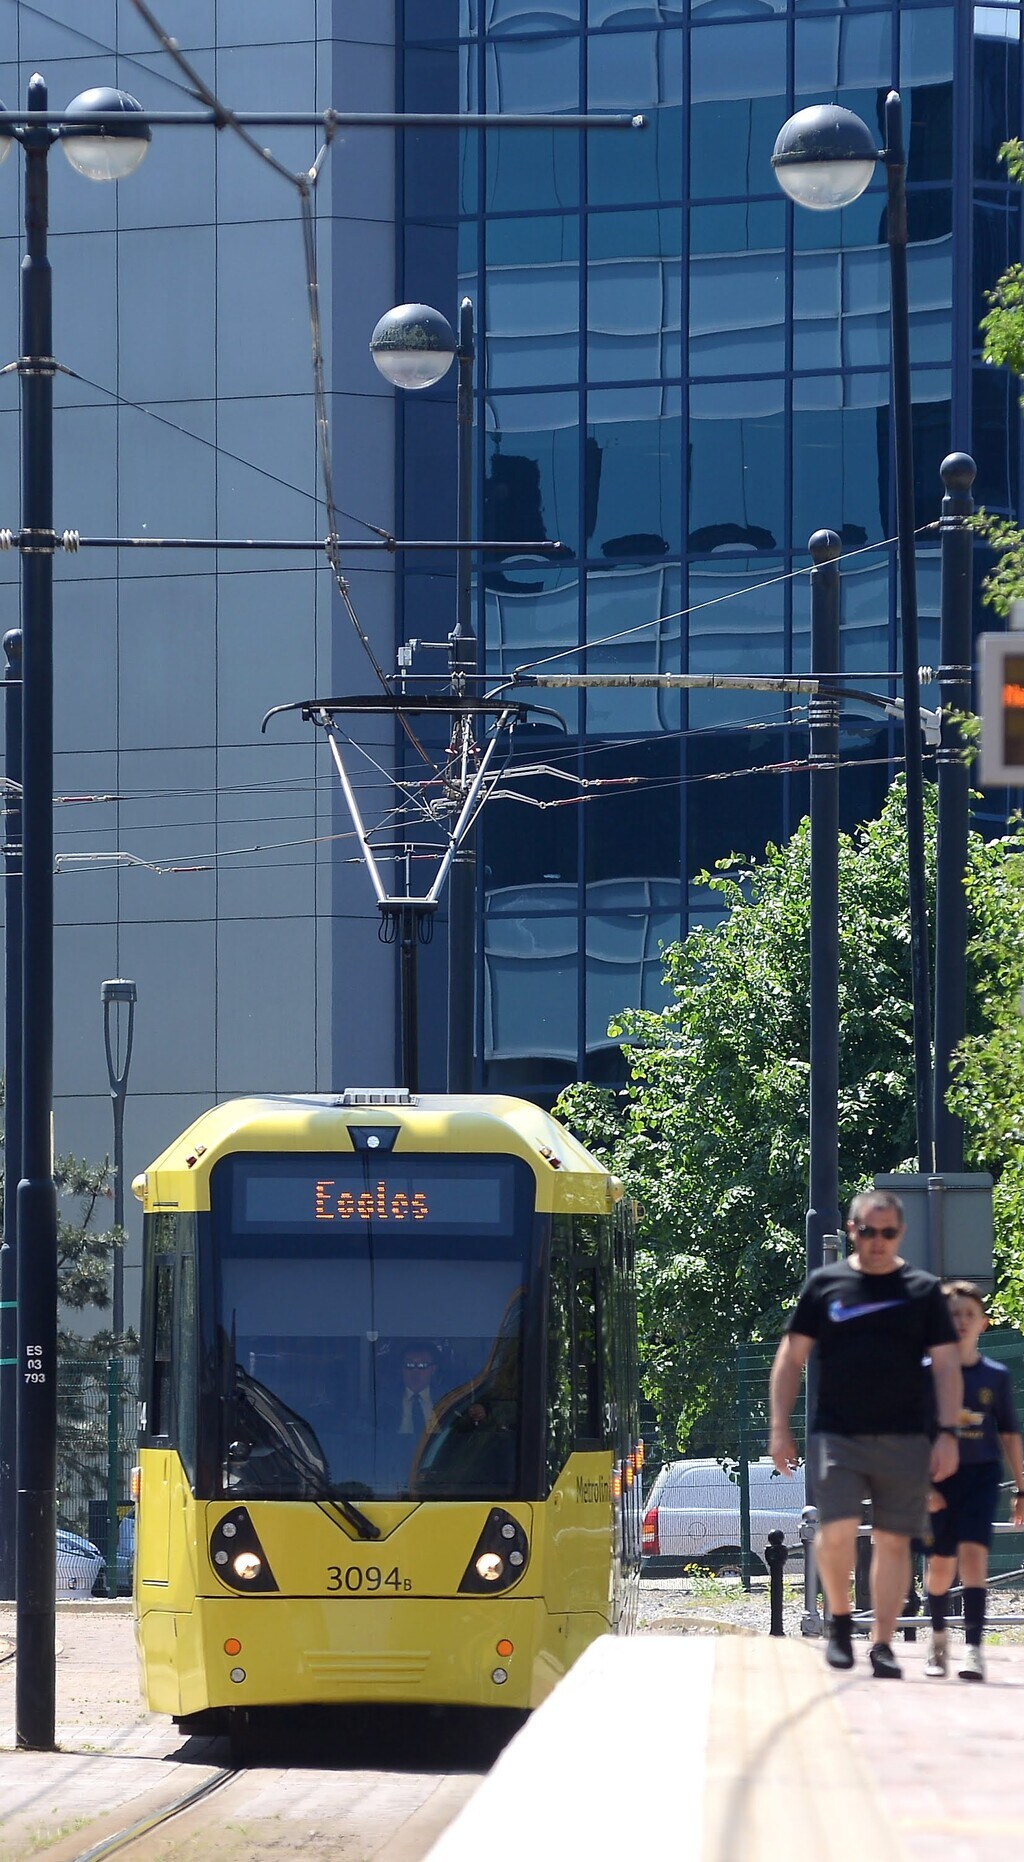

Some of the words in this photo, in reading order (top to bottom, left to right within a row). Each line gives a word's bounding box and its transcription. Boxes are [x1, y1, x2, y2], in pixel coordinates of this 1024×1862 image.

[26, 1345, 43, 1356] ES
[27, 1359, 42, 1370] 03
[24, 1373, 46, 1384] 793
